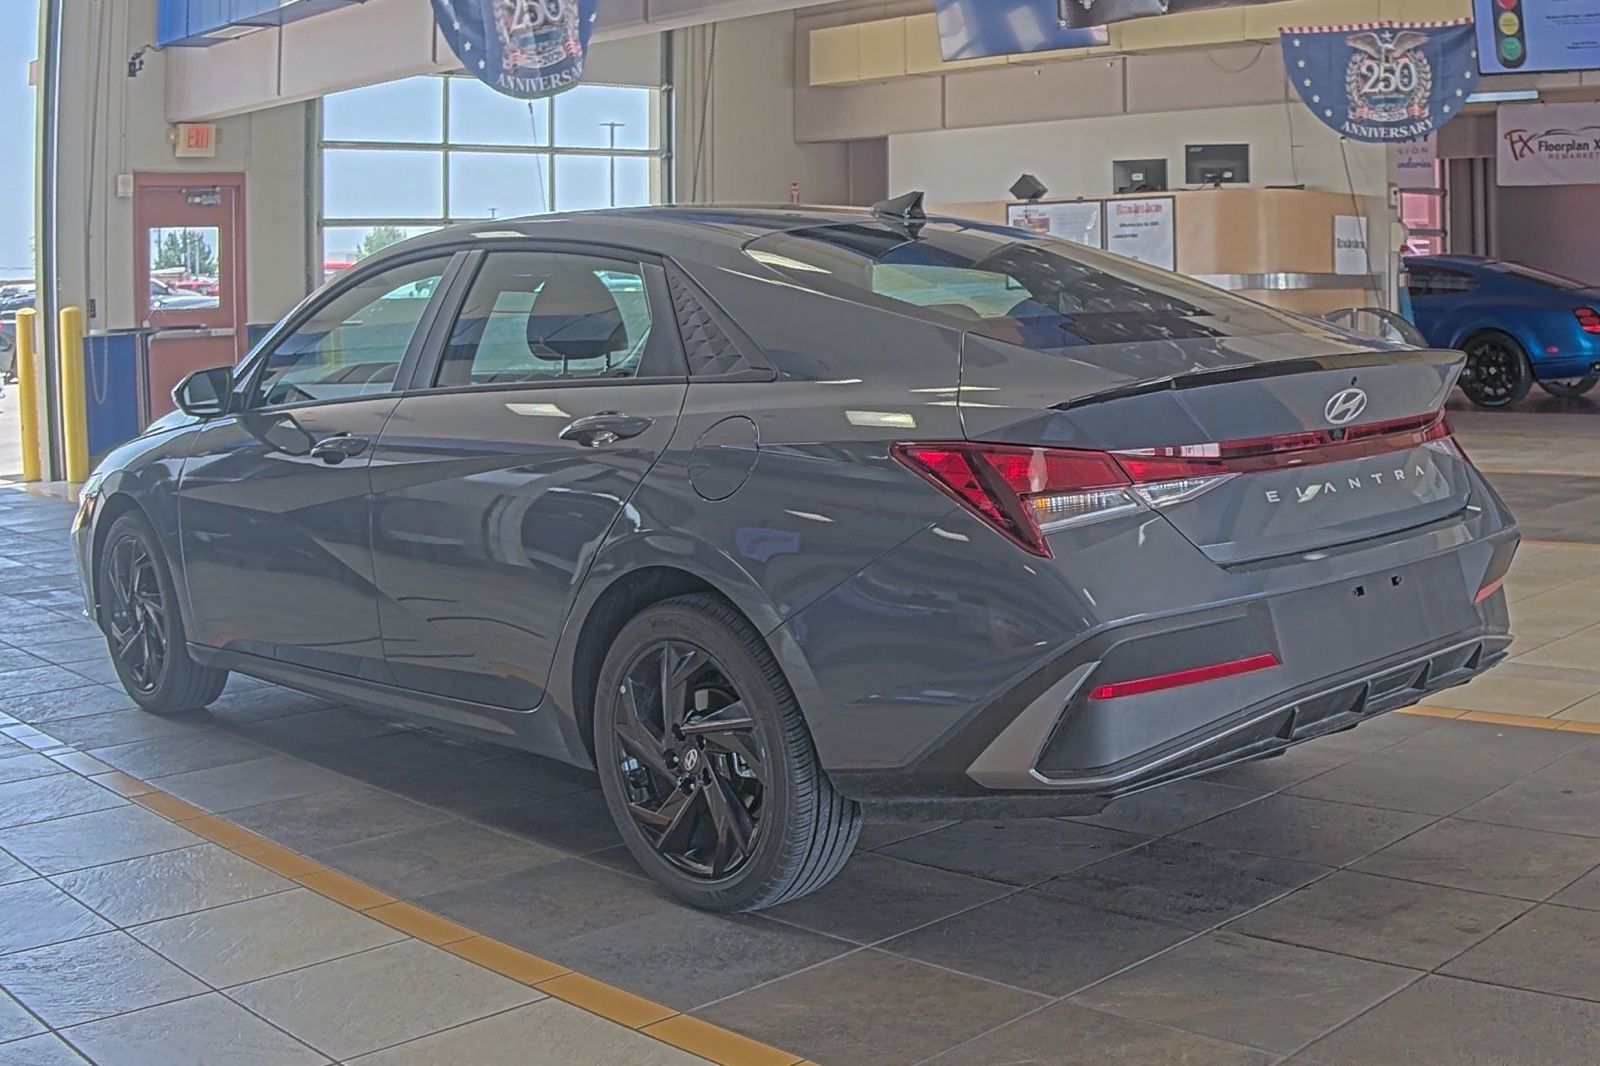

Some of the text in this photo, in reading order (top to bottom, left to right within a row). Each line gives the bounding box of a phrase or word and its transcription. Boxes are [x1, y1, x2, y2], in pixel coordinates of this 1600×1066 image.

[1360, 61, 1416, 93] 250
[187, 127, 209, 148] EXIT
[1341, 119, 1433, 138] ANNIVERSARY
[1538, 140, 1589, 153] Floorplan
[1265, 466, 1425, 503] ELANTRA
